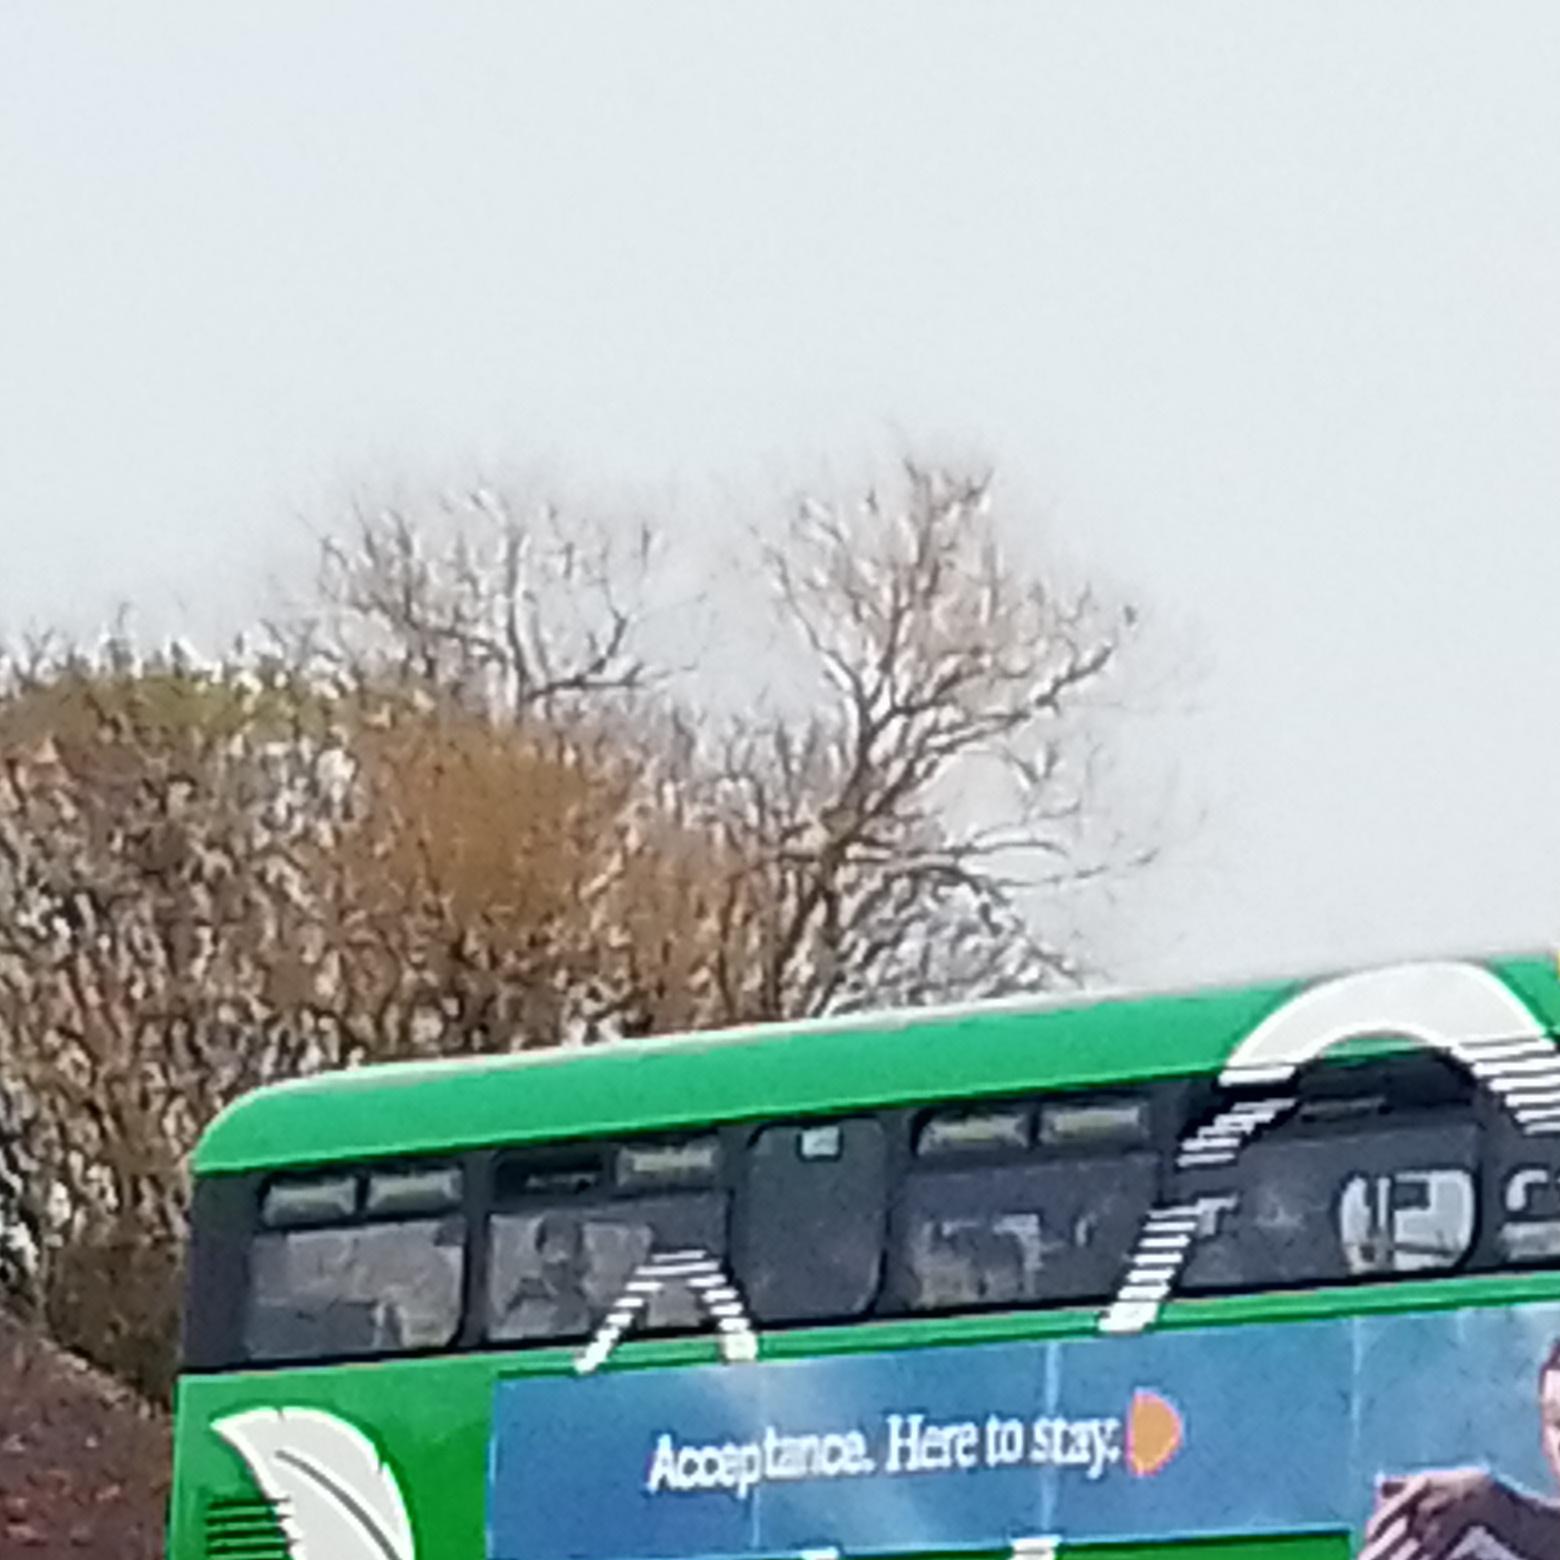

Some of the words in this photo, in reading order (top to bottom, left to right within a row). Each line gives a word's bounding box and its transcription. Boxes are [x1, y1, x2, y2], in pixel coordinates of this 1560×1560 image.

[646, 1427, 877, 1500] Acceptance.
[885, 1413, 979, 1473] Here
[985, 1414, 1024, 1467] to
[1029, 1413, 1121, 1480] stay.
